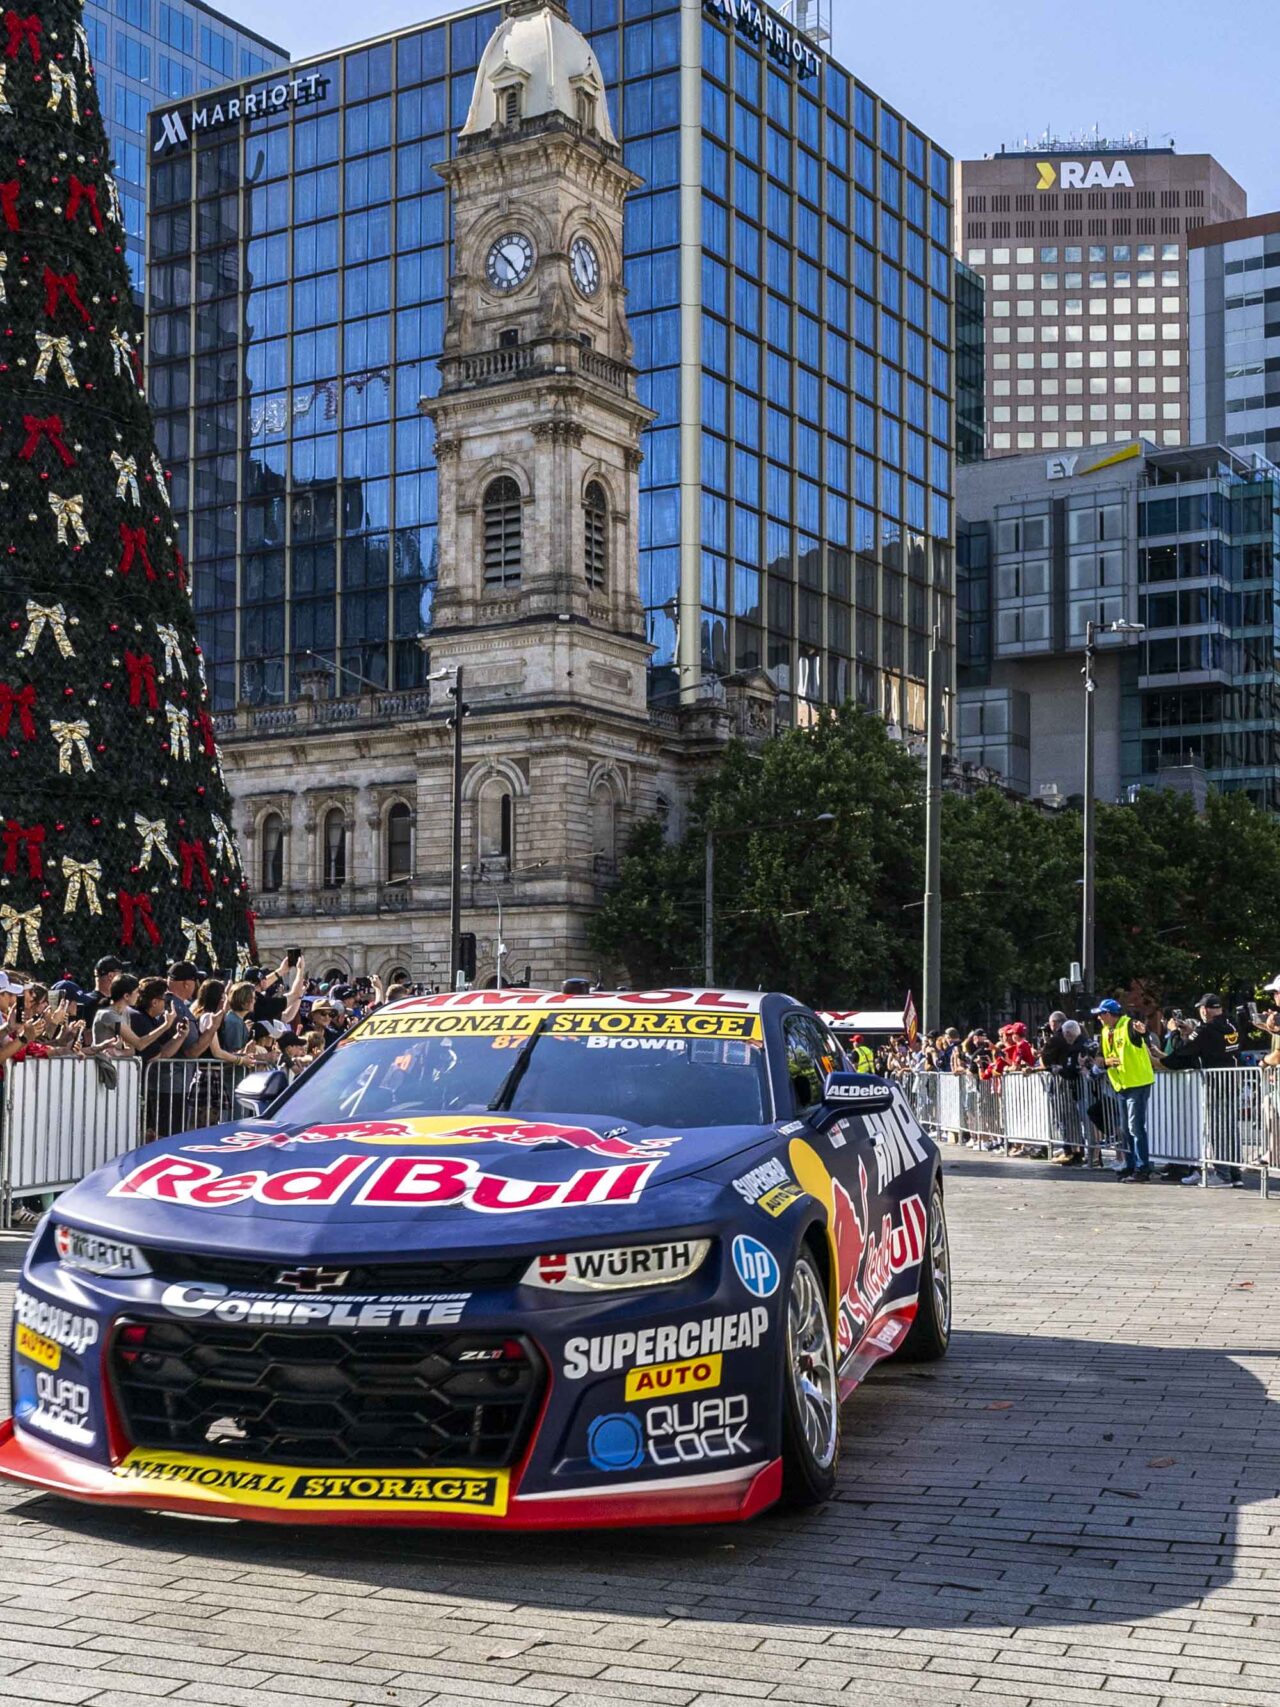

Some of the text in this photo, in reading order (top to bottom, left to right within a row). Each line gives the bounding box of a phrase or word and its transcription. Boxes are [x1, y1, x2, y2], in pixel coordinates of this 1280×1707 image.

[740, 0, 821, 76] MARRIOTT
[192, 73, 320, 130] MARRIOTT
[1060, 160, 1135, 189] RAA
[1046, 455, 1078, 480] EY
[389, 990, 749, 1010] AMPOL
[356, 1013, 747, 1037] NATIONAL STORAGE
[491, 1035, 528, 1049] 87
[586, 1036, 687, 1051] Brown
[826, 1084, 890, 1097] ACDelco
[110, 1154, 660, 1213] Red Bull
[766, 1192, 790, 1212] AUTO
[574, 1241, 691, 1278] WÜRTH
[740, 1239, 771, 1297] hp
[161, 1280, 466, 1327] COMPLETE
[228, 1290, 277, 1299] PARTS
[286, 1293, 381, 1302] EQUIPMENT
[381, 1292, 472, 1302] SOLUTIONS
[21, 1333, 56, 1359] AUTO
[563, 1305, 769, 1380] SUPERCHEAP
[36, 1371, 90, 1414] QUAD
[635, 1362, 712, 1392] AUTO
[646, 1394, 749, 1434] QUAD
[647, 1423, 751, 1466] LOCK
[120, 1460, 487, 1502] NATIONAL STORAGE
